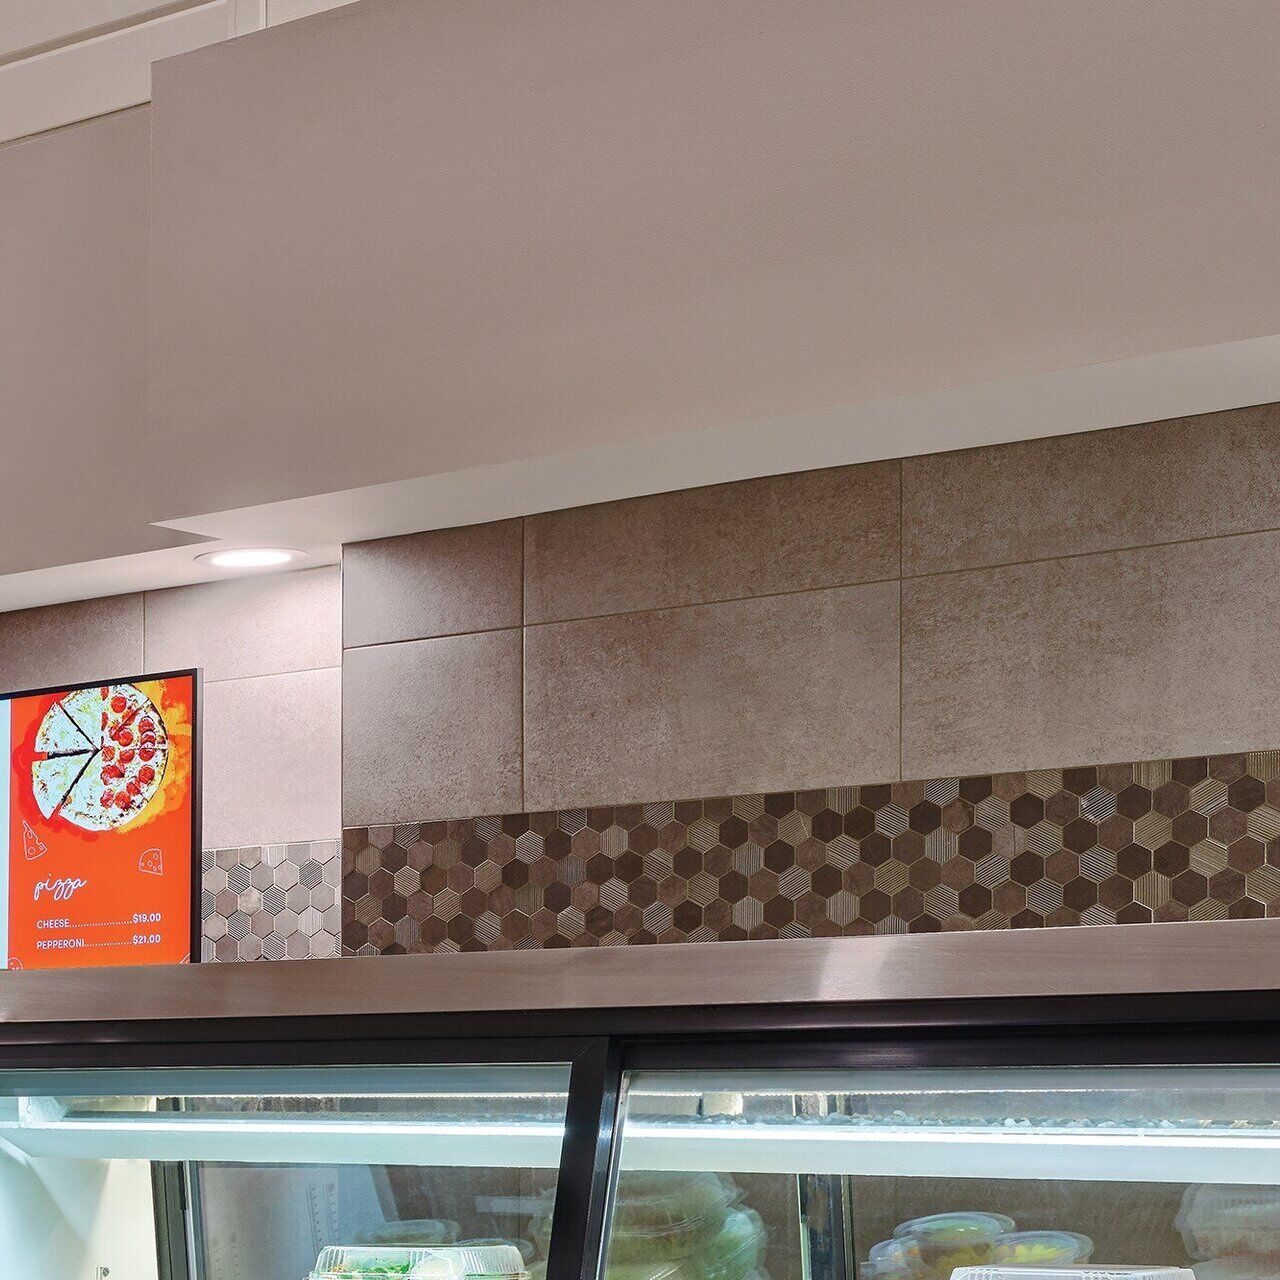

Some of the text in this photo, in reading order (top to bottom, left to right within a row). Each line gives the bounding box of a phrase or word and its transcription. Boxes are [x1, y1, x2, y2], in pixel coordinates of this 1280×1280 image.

[33, 873, 88, 901] pizza
[36, 912, 162, 929] CHEESE $19.00
[36, 934, 162, 950] PEPPERONI $21.00
